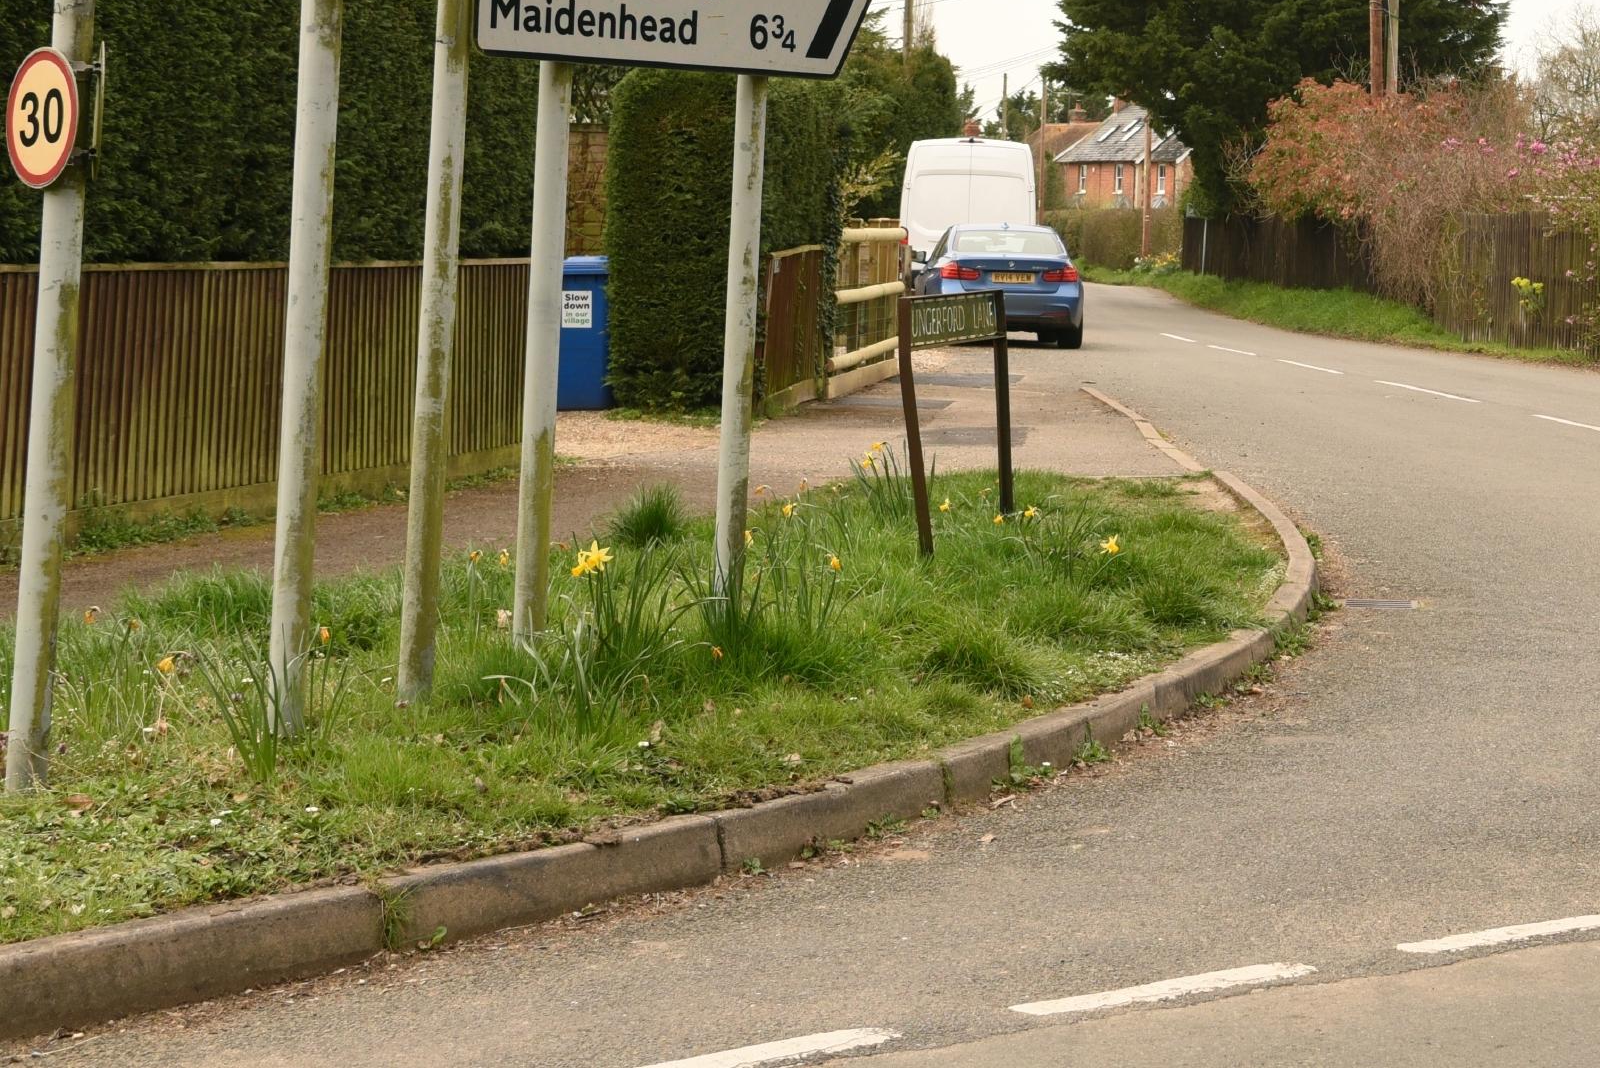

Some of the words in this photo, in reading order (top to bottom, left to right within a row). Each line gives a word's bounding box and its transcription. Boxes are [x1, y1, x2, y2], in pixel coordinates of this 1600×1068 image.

[19, 88, 64, 147] 30
[565, 293, 589, 301] Slow
[911, 305, 966, 337] UNGERFORD
[972, 301, 994, 329] LANE
